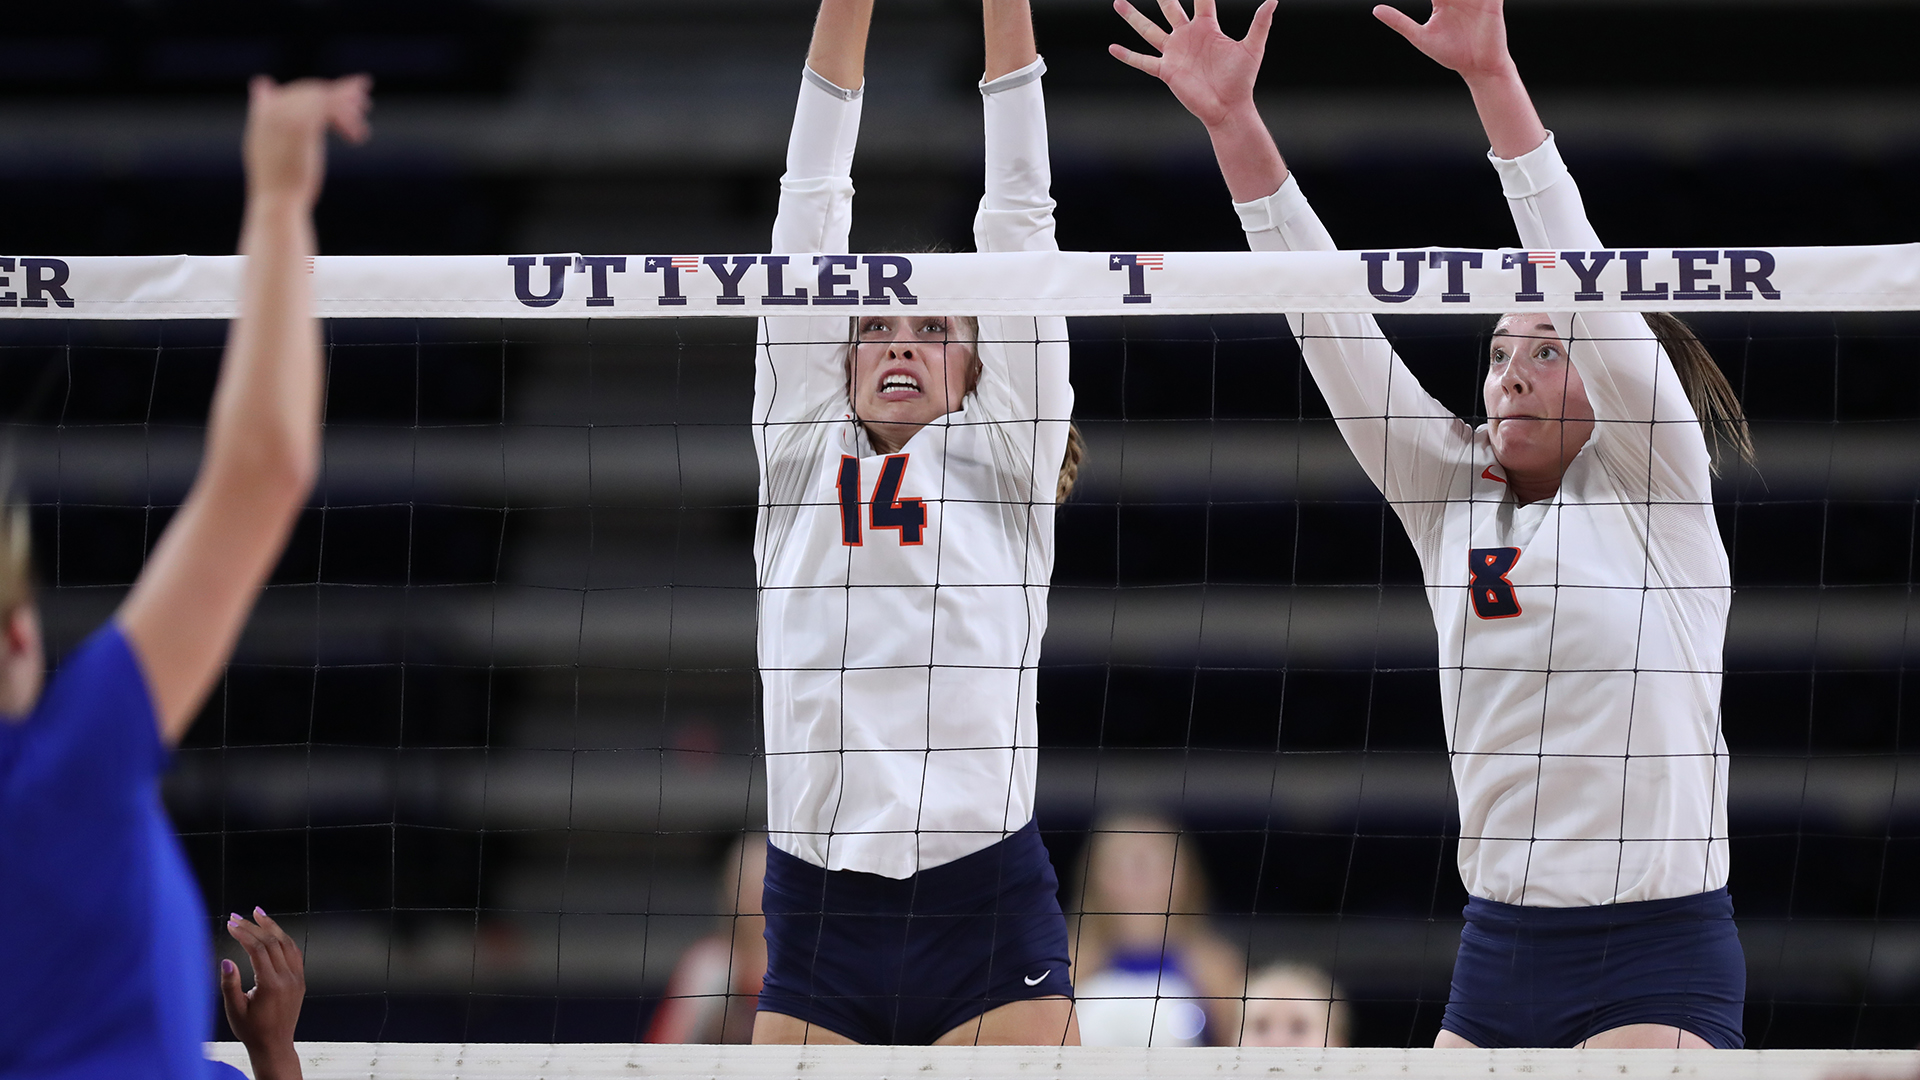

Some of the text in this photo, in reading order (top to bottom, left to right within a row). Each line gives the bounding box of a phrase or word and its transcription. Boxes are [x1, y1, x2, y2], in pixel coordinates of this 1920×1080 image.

[507, 255, 918, 307] UT TYLER
[1109, 253, 1164, 304] T
[1360, 250, 1781, 303] UT TYLER
[836, 453, 927, 546] 14
[1468, 547, 1522, 620] 8
